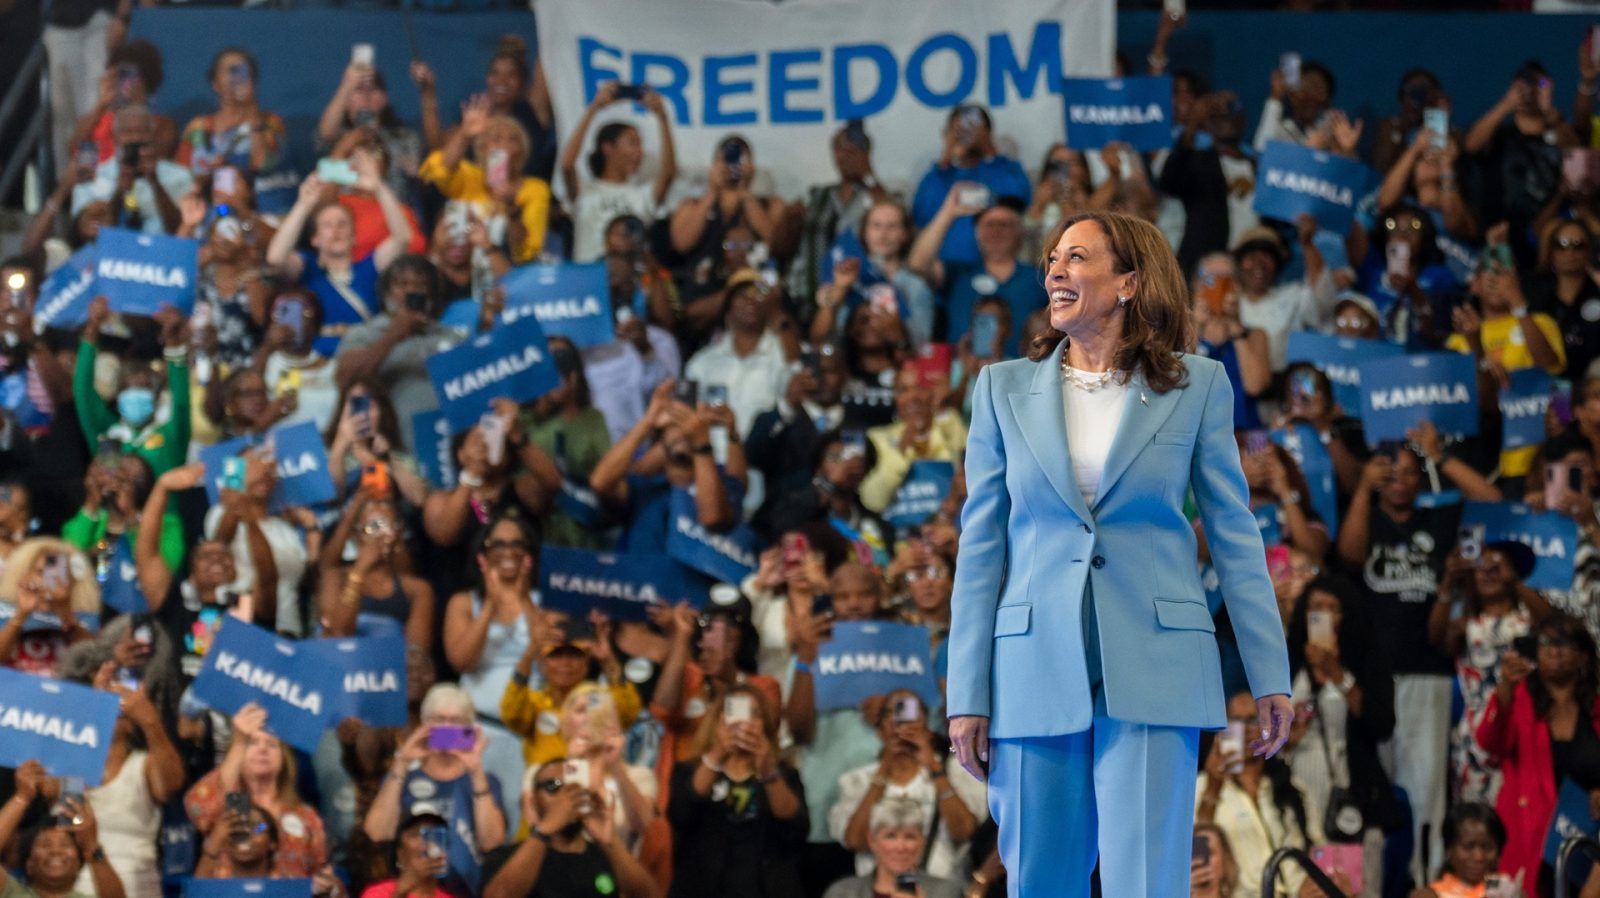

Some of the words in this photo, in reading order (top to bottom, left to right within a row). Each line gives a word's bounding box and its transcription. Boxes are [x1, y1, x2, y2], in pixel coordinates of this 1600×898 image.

[579, 22, 1063, 126] FREEDOM
[1070, 104, 1164, 125] KAMALA
[1265, 168, 1353, 208] KAMALA
[100, 258, 187, 289] KAMALA
[443, 345, 542, 401] KAMALA
[1370, 384, 1470, 411] KAMALA
[549, 573, 657, 603] KAMALA
[819, 653, 923, 675] KAMALA
[216, 652, 321, 715] KAMALA
